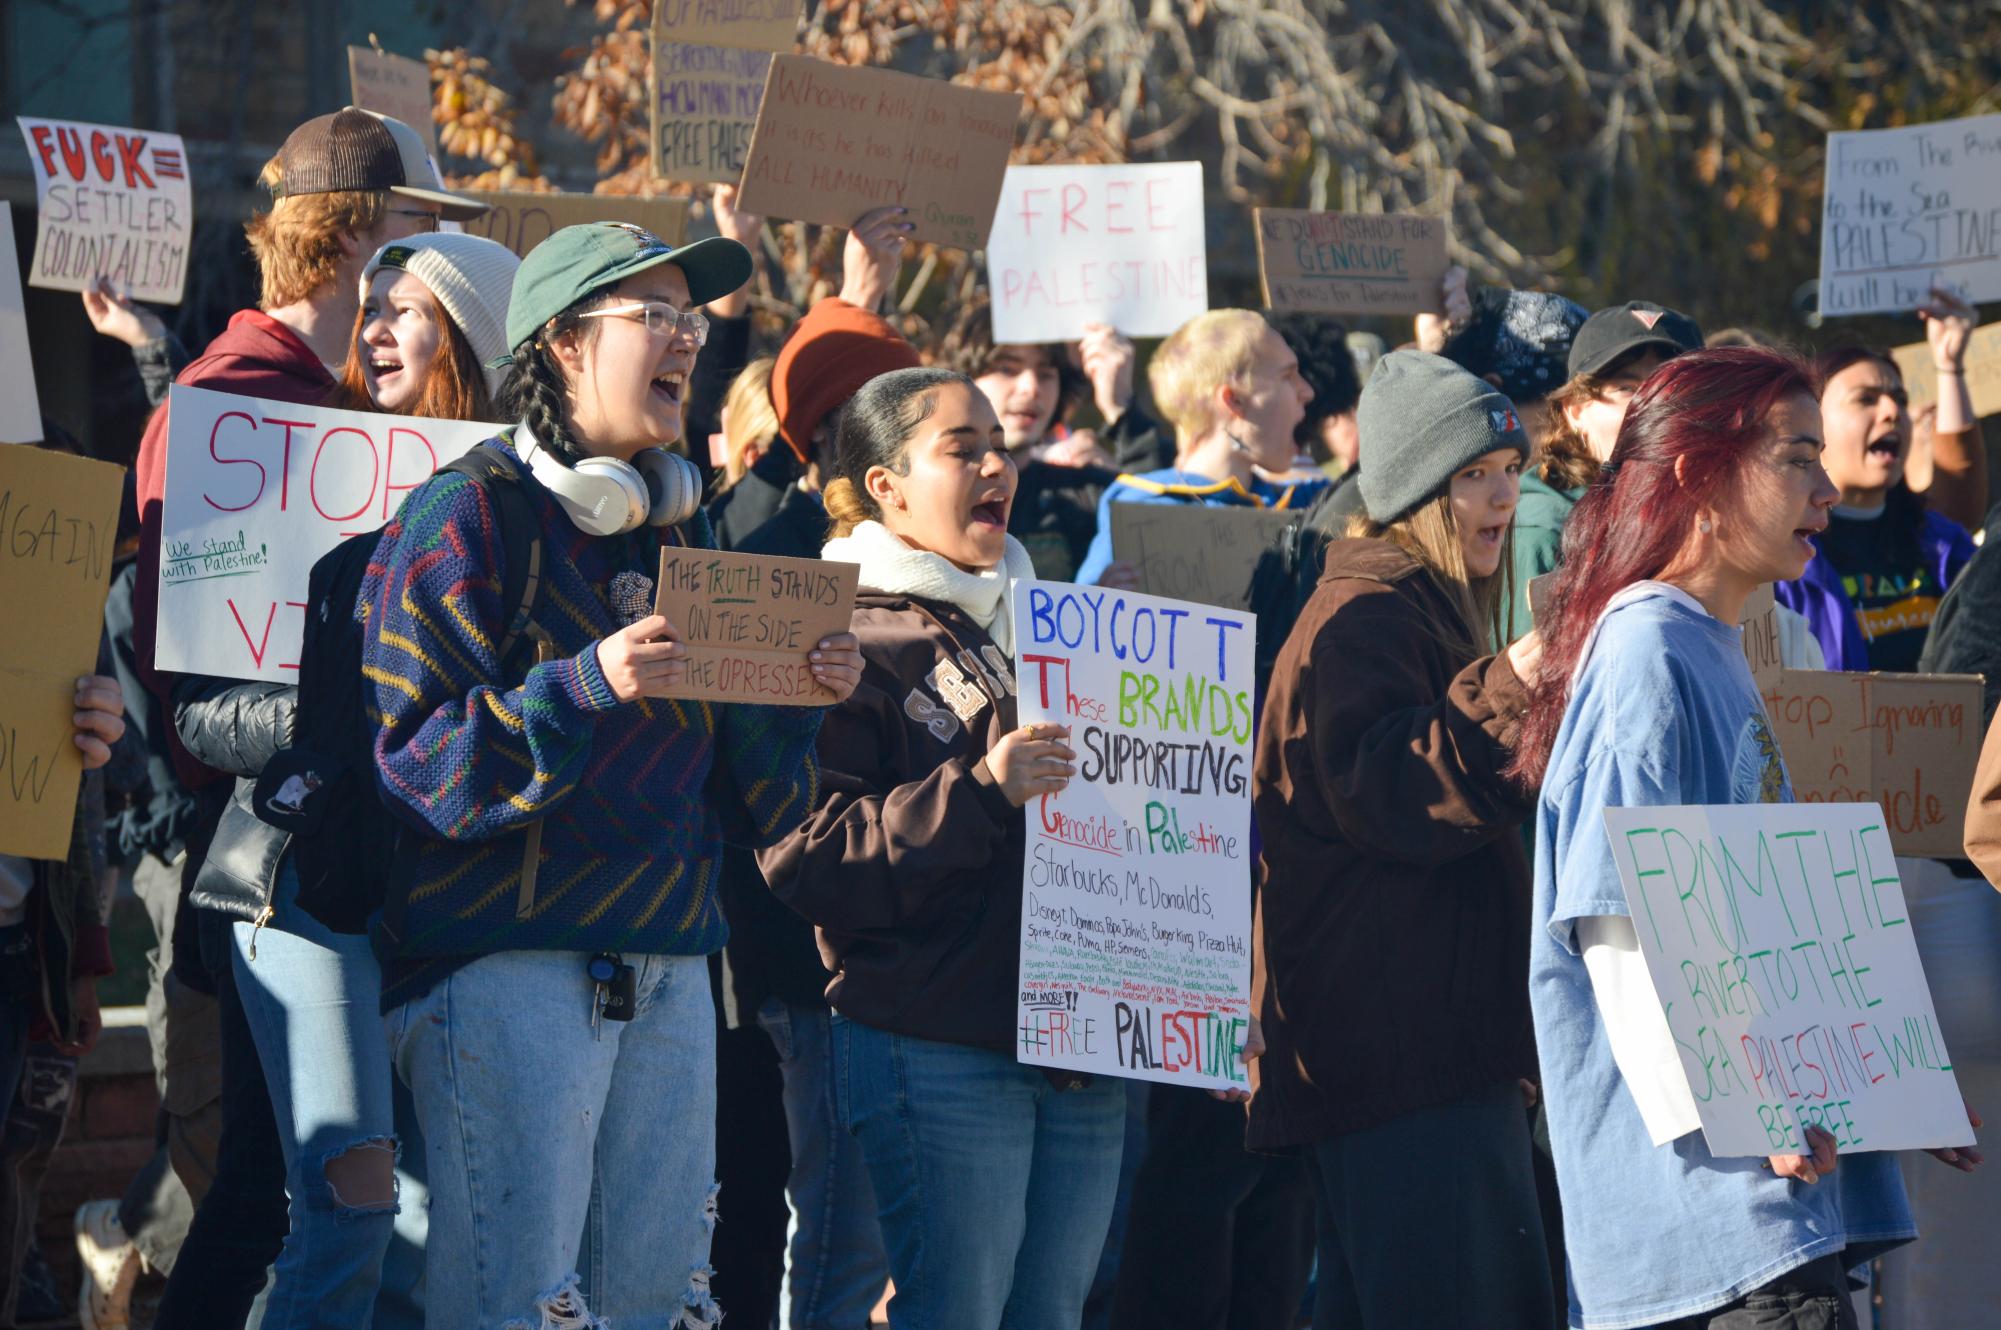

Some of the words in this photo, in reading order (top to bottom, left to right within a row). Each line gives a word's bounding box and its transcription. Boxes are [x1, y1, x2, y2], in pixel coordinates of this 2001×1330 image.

[777, 66, 867, 113] Whoever
[30, 126, 157, 190] FUCK
[753, 155, 794, 185] ALL
[809, 164, 909, 202] HUMANITY
[1836, 137, 1900, 180] From
[1909, 132, 1953, 168] The
[46, 184, 183, 232] SETTLER
[1017, 177, 1178, 239] FREE
[1401, 218, 1432, 241] FOR
[1853, 188, 1899, 219] the
[40, 225, 184, 290] COLONIALISM
[1002, 255, 1208, 309] PALESTINE
[1295, 239, 1409, 275] GENOCIDE
[203, 411, 438, 521] STOP
[161, 560, 197, 578] with
[204, 543, 268, 573] Palestine!
[165, 540, 193, 558] We
[203, 529, 247, 555] stand
[667, 557, 703, 592] THE
[706, 560, 761, 595] TRUTH
[770, 568, 840, 606] STANDS
[687, 603, 711, 641] ON
[717, 610, 750, 643] THE
[755, 614, 802, 649] SIDE
[1030, 588, 1243, 682] BOYCOTT
[1022, 653, 1109, 723] These
[1118, 670, 1252, 746] BRANDS
[1850, 677, 1965, 757] Ignoring
[1081, 725, 1248, 799] SUPPORTING
[1039, 789, 1123, 852] Genocide
[1123, 820, 1142, 855] in
[1145, 800, 1240, 859] Palestine
[1775, 823, 1906, 938] THE
[1020, 989, 1037, 1002] and
[1680, 955, 1771, 1018] RIVER
[1748, 948, 1799, 1010] TO
[1790, 933, 1883, 1011] THE
[1114, 1001, 1248, 1083] PALESTINE
[1664, 1001, 1749, 1102] SEA
[1740, 1022, 1886, 1101] PALESTINE
[1872, 1013, 1954, 1079] WILL
[1757, 1103, 1800, 1149] BE
